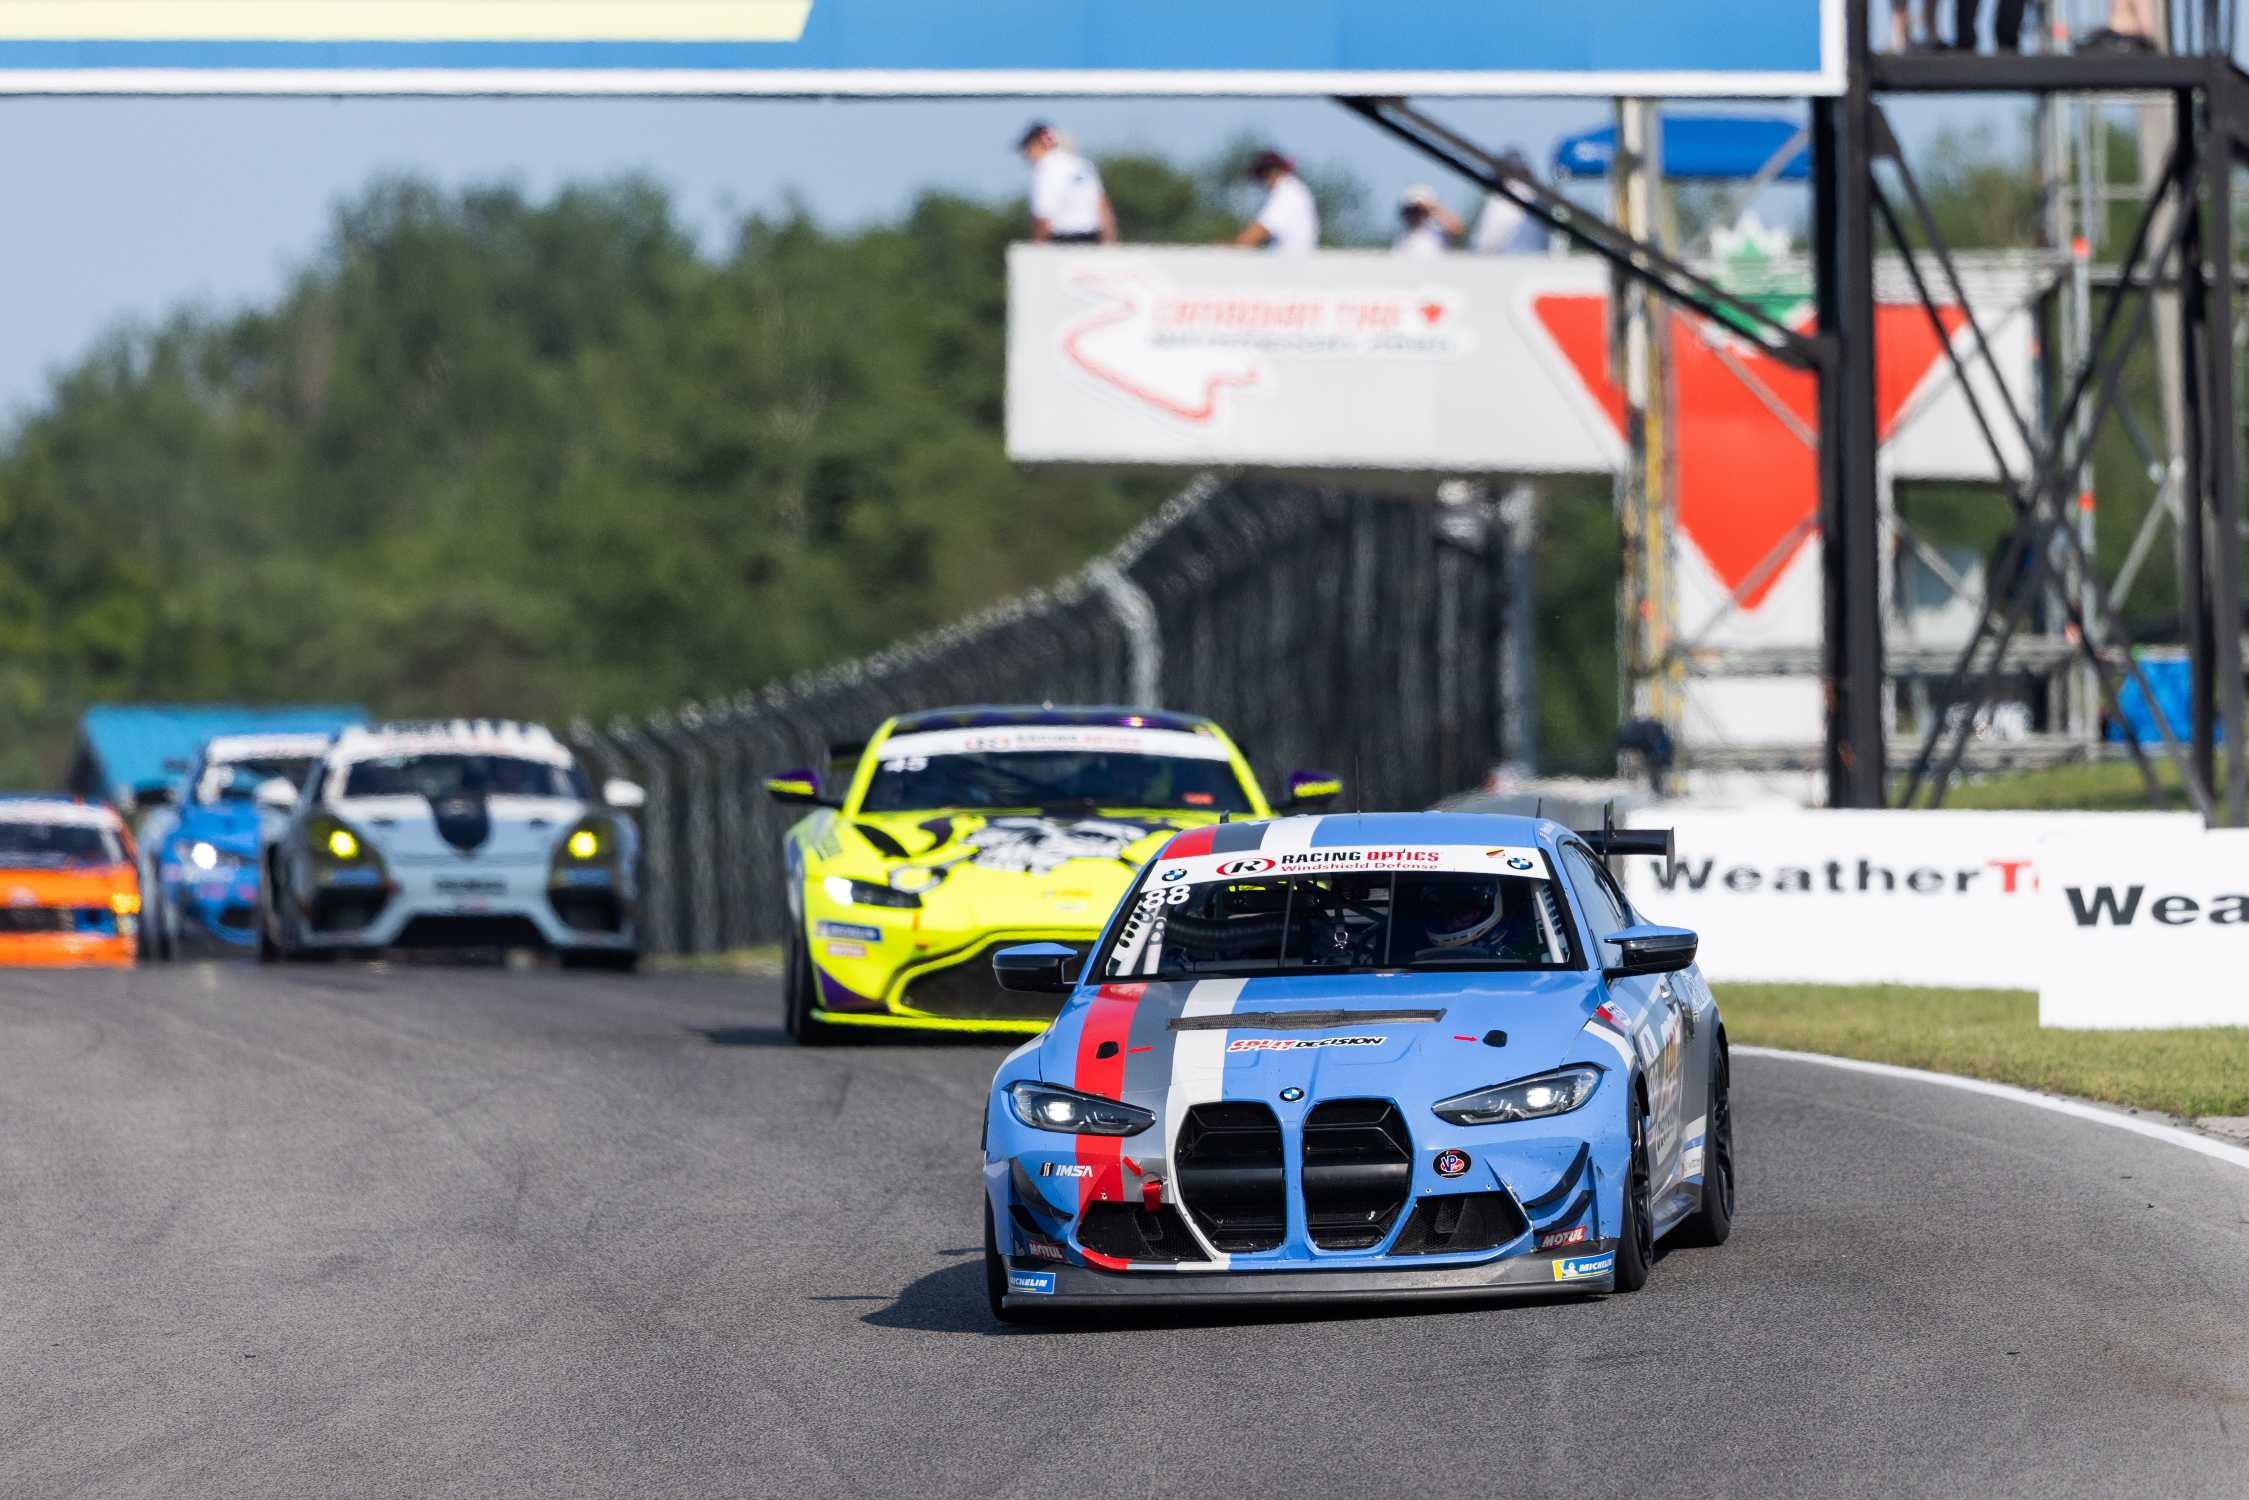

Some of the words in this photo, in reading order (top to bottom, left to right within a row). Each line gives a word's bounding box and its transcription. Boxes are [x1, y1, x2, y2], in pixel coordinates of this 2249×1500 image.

[1281, 851, 1361, 864] RACING
[1366, 851, 1439, 862] OPTICS
[1281, 862, 1369, 872] Windshield
[1374, 862, 1438, 870] Defense
[1650, 857, 2040, 891] WeatherT
[1143, 885, 1191, 910] 88
[1055, 1164, 1094, 1178] IMSA
[1542, 1227, 1584, 1248] MOTUL
